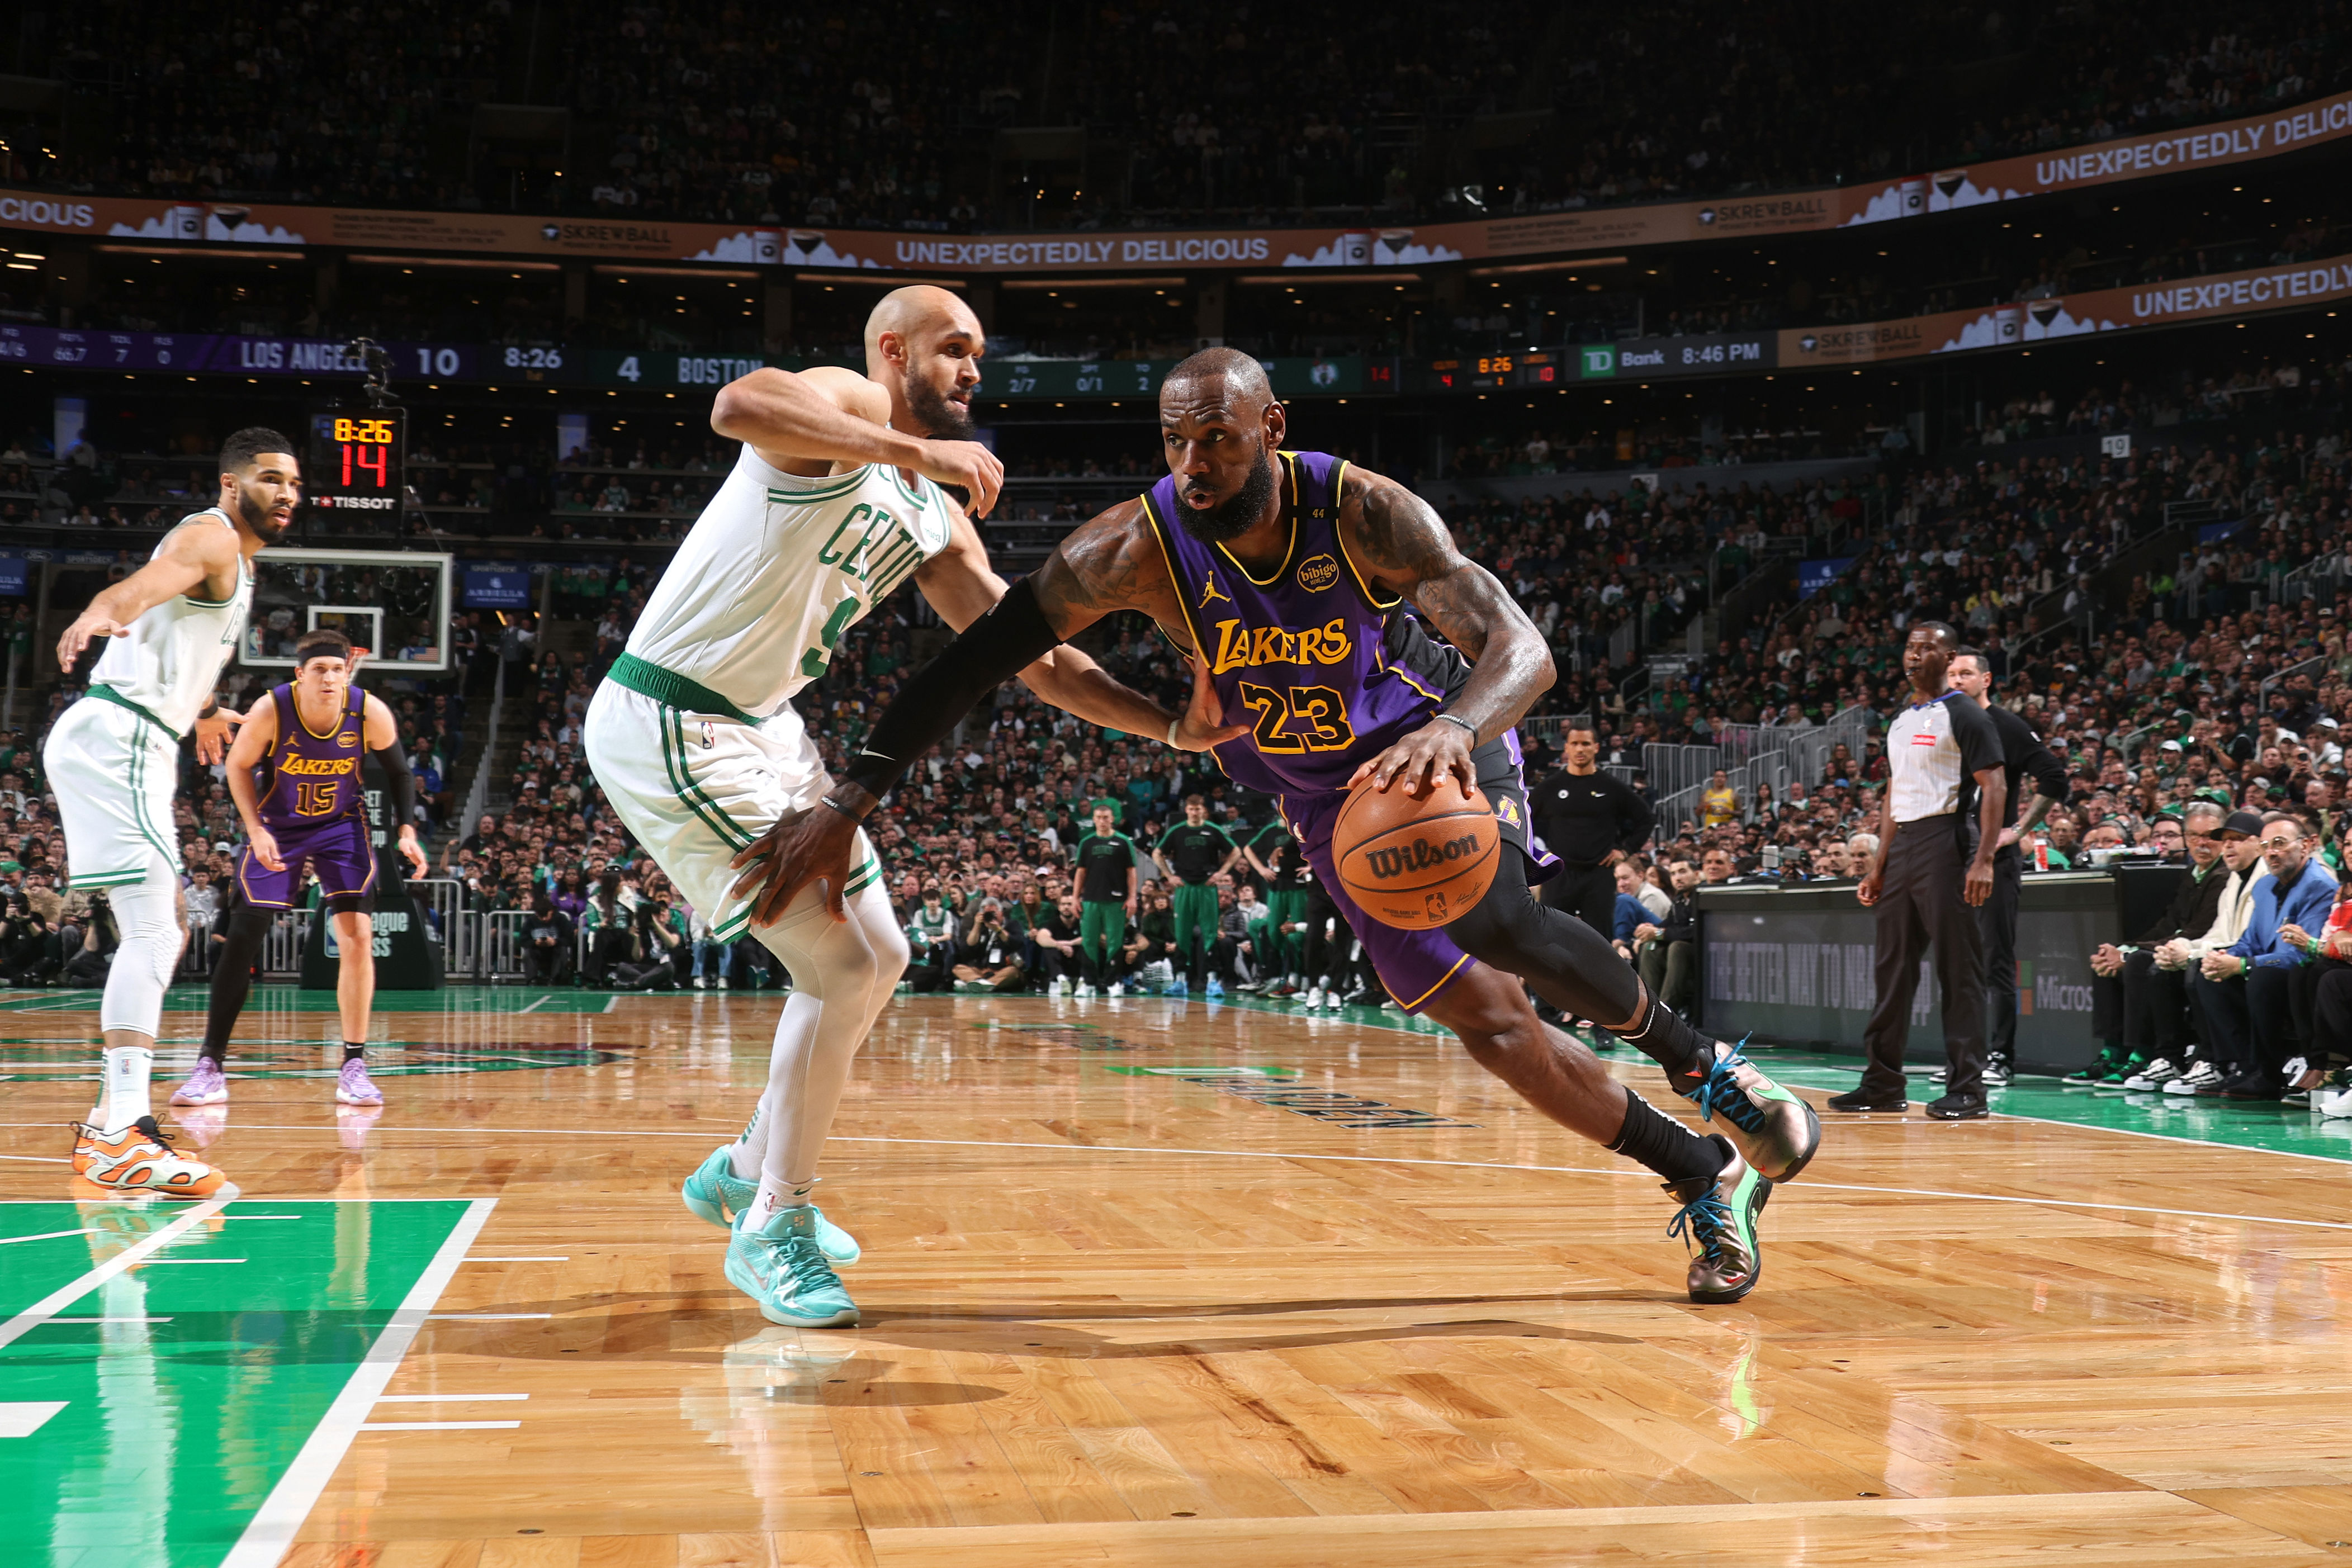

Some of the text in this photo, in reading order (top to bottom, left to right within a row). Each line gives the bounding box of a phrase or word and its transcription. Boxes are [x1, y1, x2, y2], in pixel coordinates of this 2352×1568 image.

[2036, 125, 2265, 185] UNEXPECTEDLY
[0, 197, 94, 227] CIOUS
[897, 238, 1269, 264] UNEXPECTEDLY DELICIOUS
[2133, 264, 2352, 318] UNEXPECTEDLY
[242, 342, 370, 372] LOS ANGE
[417, 348, 460, 376] 10
[504, 347, 562, 369] 8:26
[1584, 349, 1665, 371] TD Bank
[1682, 342, 1761, 364] 8:46 PM
[617, 356, 641, 382] 4
[1371, 367, 1391, 382] 14
[1009, 377, 1037, 392] 2/7
[1076, 377, 1103, 391] 0/1
[1137, 377, 1149, 391] 2
[334, 418, 396, 443] 8:26
[342, 444, 387, 488] 14
[333, 496, 395, 510] TISSOT
[1312, 508, 1325, 518] 44
[818, 503, 925, 610] CELTIC
[1301, 563, 1336, 582] bibigo
[1212, 618, 1352, 675] LAKERS
[1238, 680, 1356, 755] 23
[278, 752, 358, 776] LAKERS
[295, 781, 339, 817] 15
[371, 830, 387, 849] pp
[1366, 833, 1480, 880] Wilson
[371, 912, 409, 937] ague
[371, 937, 391, 958] ss
[1709, 942, 1733, 1001] THE
[1736, 942, 1785, 1004] BETTER
[1821, 944, 1841, 1007] TO
[2037, 974, 2094, 1012] Micros
[1179, 1077, 1485, 1129] GARDEN
